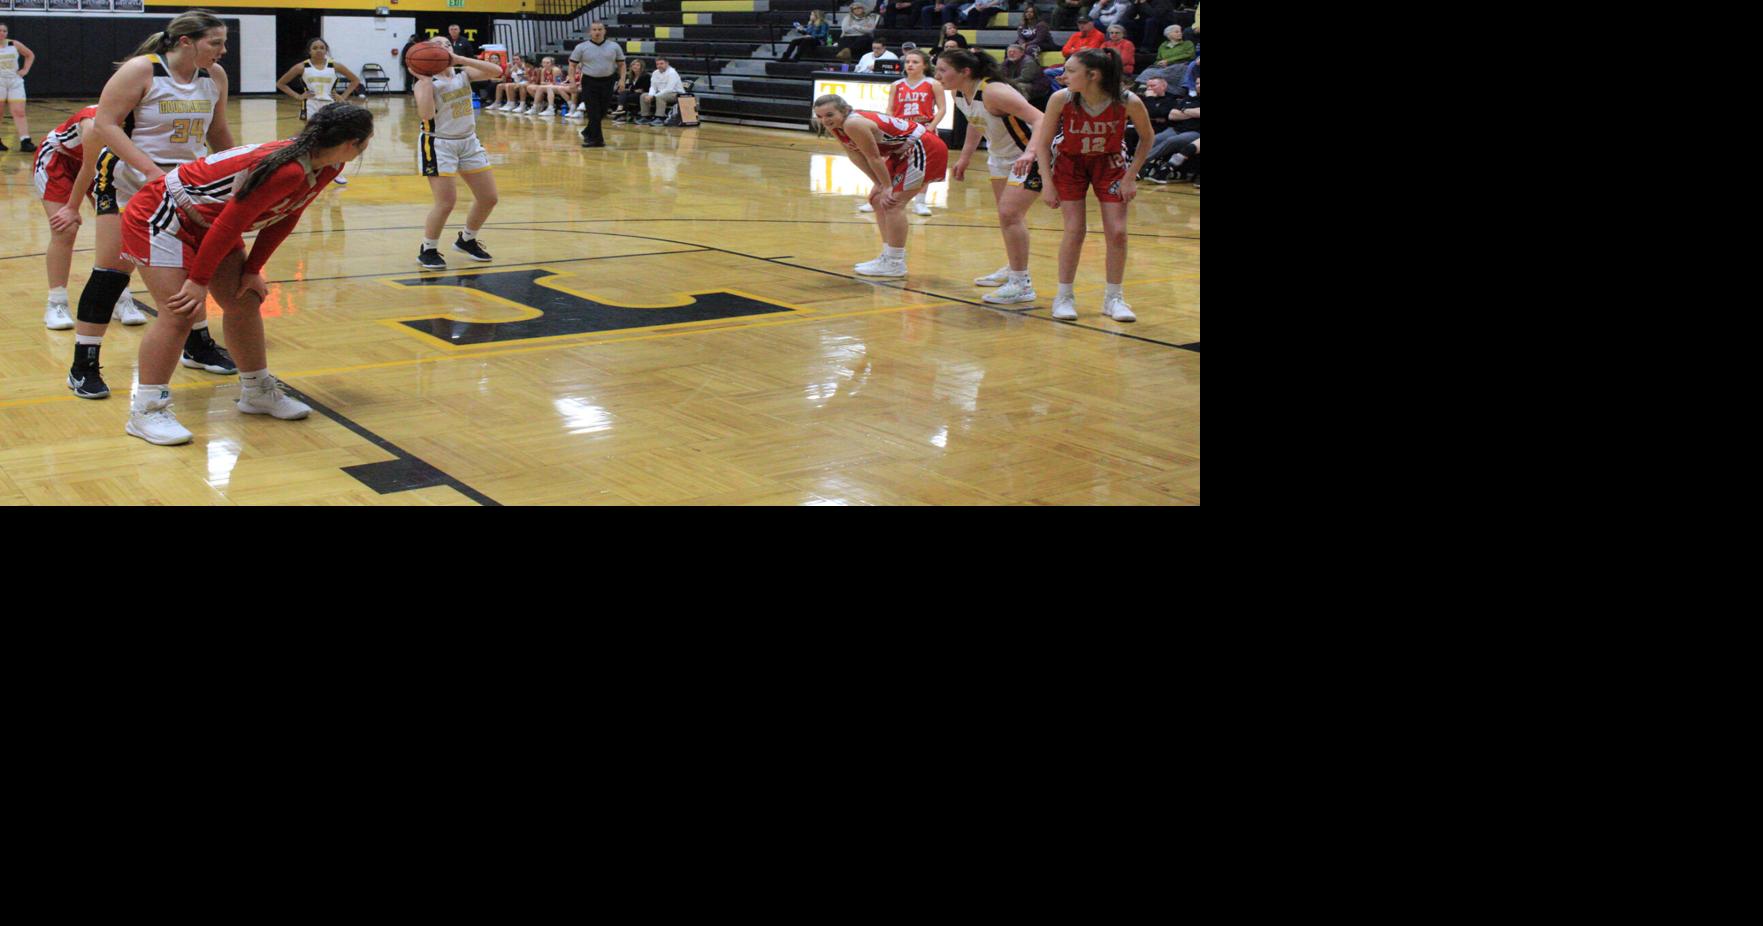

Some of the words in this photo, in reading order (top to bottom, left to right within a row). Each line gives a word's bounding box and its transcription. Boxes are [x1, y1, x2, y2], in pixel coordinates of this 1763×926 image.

[464, 29, 477, 41] T
[898, 92, 928, 102] LADY
[904, 102, 919, 115] 22
[170, 119, 204, 143] 34
[1069, 118, 1119, 134] LADY
[1081, 137, 1106, 153] 12
[1108, 153, 1124, 168] 12
